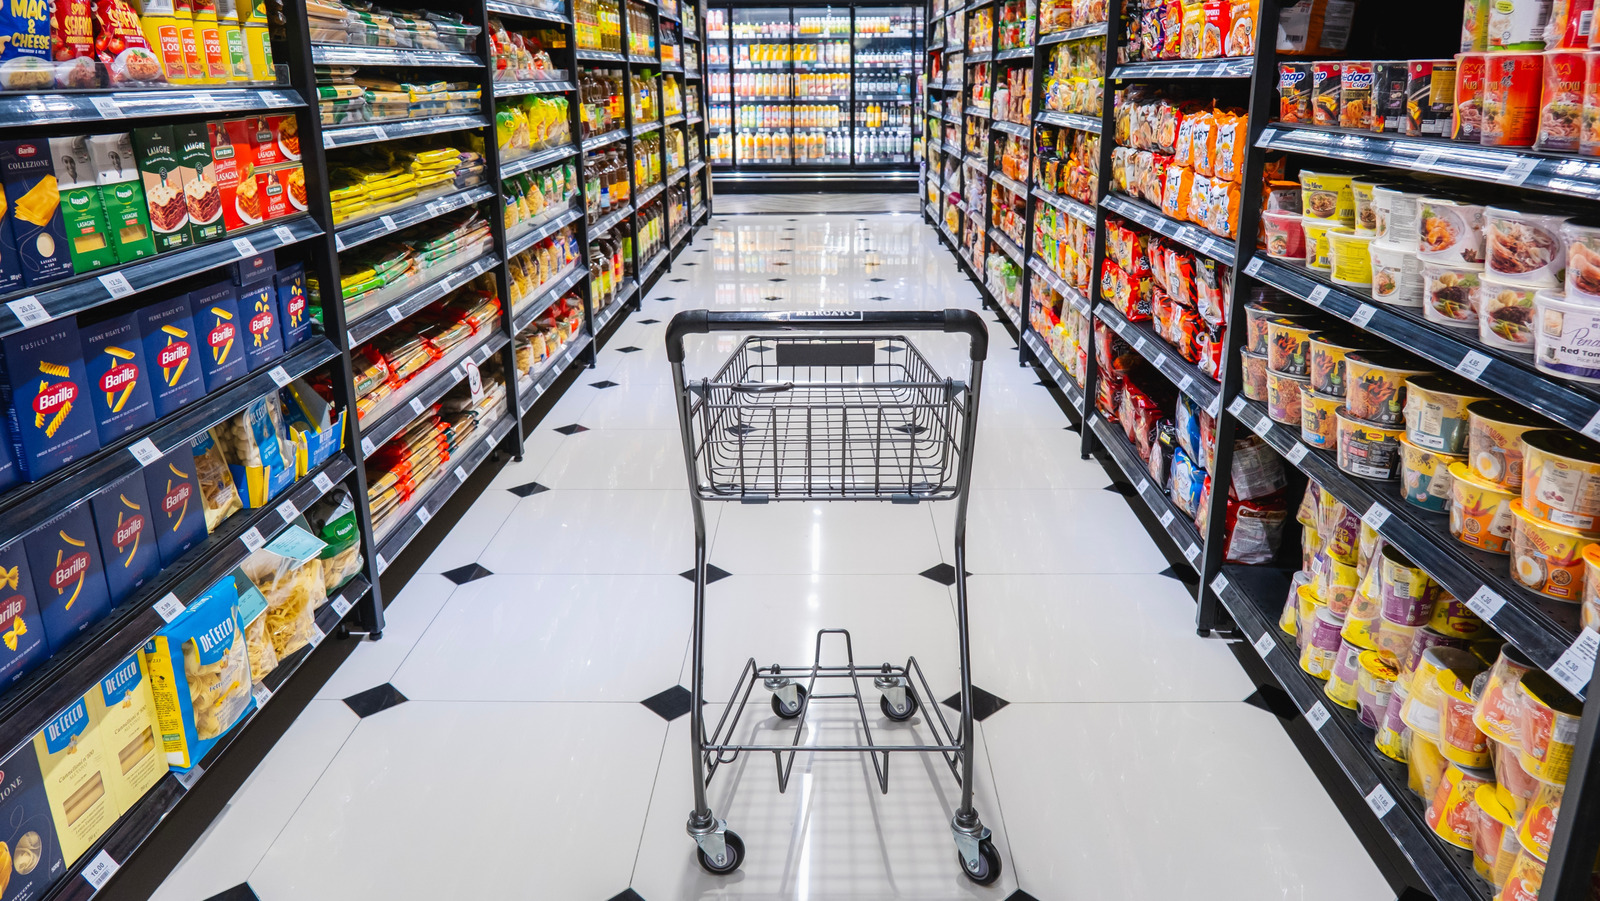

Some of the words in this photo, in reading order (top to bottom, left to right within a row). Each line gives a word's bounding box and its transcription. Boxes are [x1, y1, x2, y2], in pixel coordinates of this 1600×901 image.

[11, 0, 47, 21] MAC
[27, 19, 36, 34] &
[12, 32, 50, 49] CHEESE
[18, 147, 36, 156] Barilla
[146, 145, 170, 157] LASAGNE
[184, 142, 206, 152] LASAGNE
[8, 160, 50, 170] COLLEZIONE
[216, 171, 239, 182] LASAGNA
[77, 219, 96, 228] LASAGNE
[19, 303, 36, 313] 20.05
[290, 299, 304, 312] Barilla
[148, 313, 161, 322] PENNE
[252, 316, 272, 331] Barilla
[89, 334, 104, 344] PENNE
[105, 328, 121, 340] RIGATE
[212, 328, 233, 344] Barilla
[20, 338, 48, 351] FUSILLI
[1560, 346, 1579, 356] Red
[162, 346, 188, 365] Barilla
[105, 368, 136, 388] Barilla
[39, 387, 74, 411] Barilla
[165, 486, 189, 510] Barilla
[117, 518, 141, 544] Barilla
[56, 557, 87, 585] Barilla
[1480, 594, 1492, 605] 4.30
[199, 635, 211, 653] DE
[209, 617, 234, 646] CECCO
[1564, 659, 1579, 672] 4.30
[105, 678, 116, 695] DE
[115, 661, 137, 688] CECCO
[48, 725, 59, 741] DE
[59, 704, 83, 735] CECCO
[90, 862, 105, 877] 16.00
